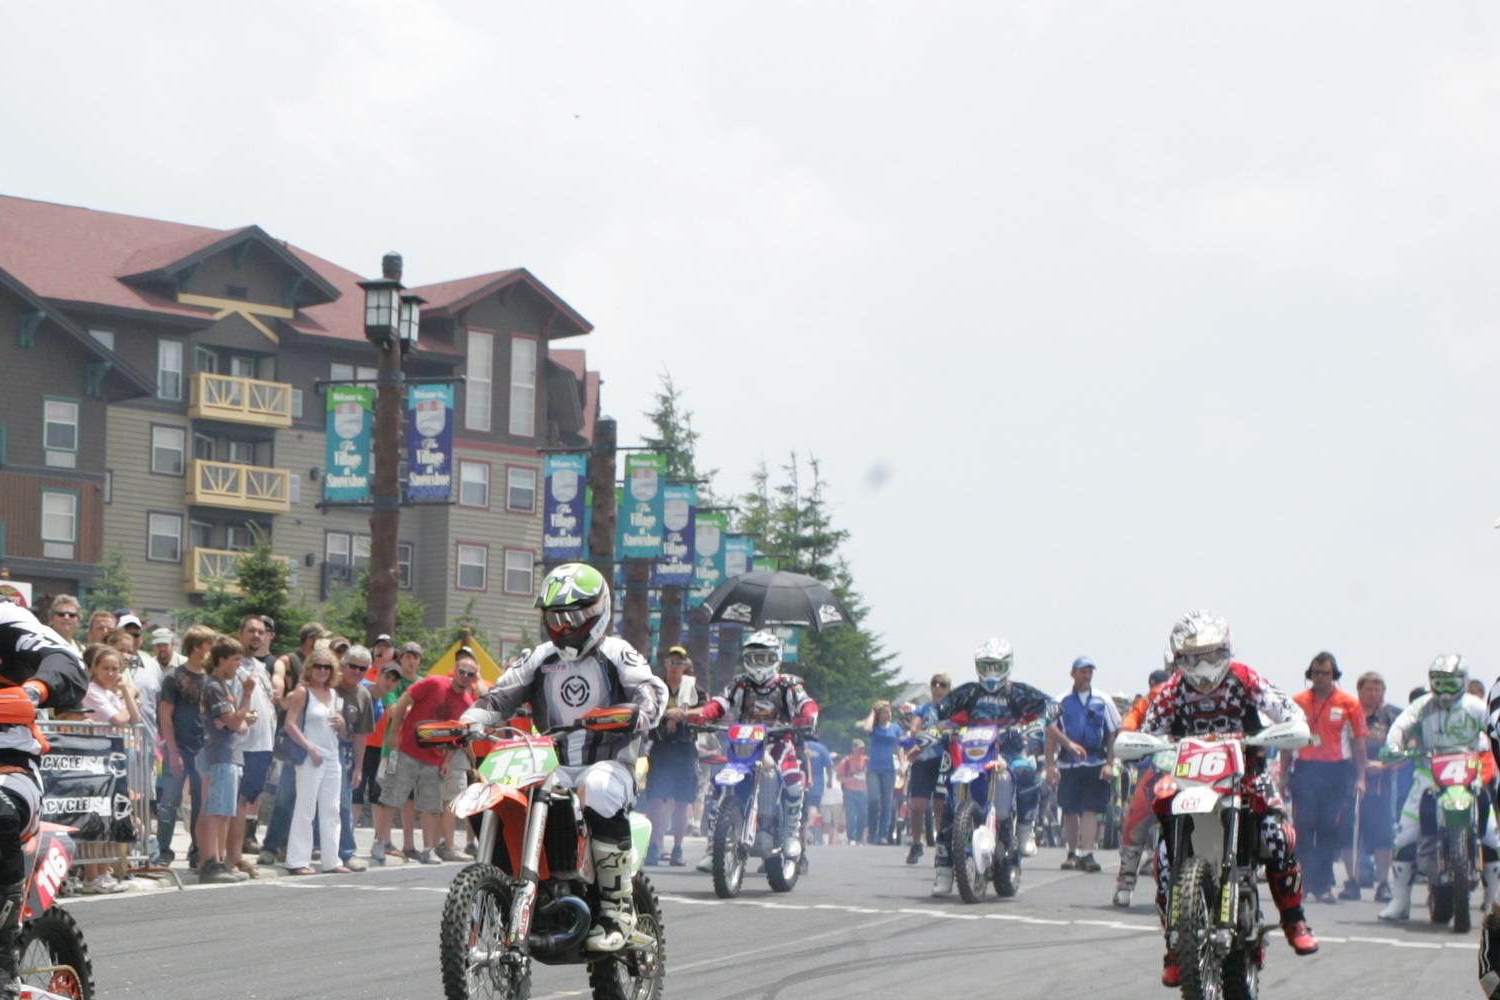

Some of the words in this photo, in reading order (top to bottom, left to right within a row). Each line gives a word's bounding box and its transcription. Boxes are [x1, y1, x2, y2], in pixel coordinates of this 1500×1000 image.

[334, 451, 362, 469] Village
[416, 449, 445, 468] Village
[550, 513, 577, 531] Village
[630, 512, 657, 529] Village
[489, 748, 548, 780] 13
[1186, 751, 1227, 778] 16
[1440, 761, 1468, 783] 4
[37, 847, 68, 897] 116
